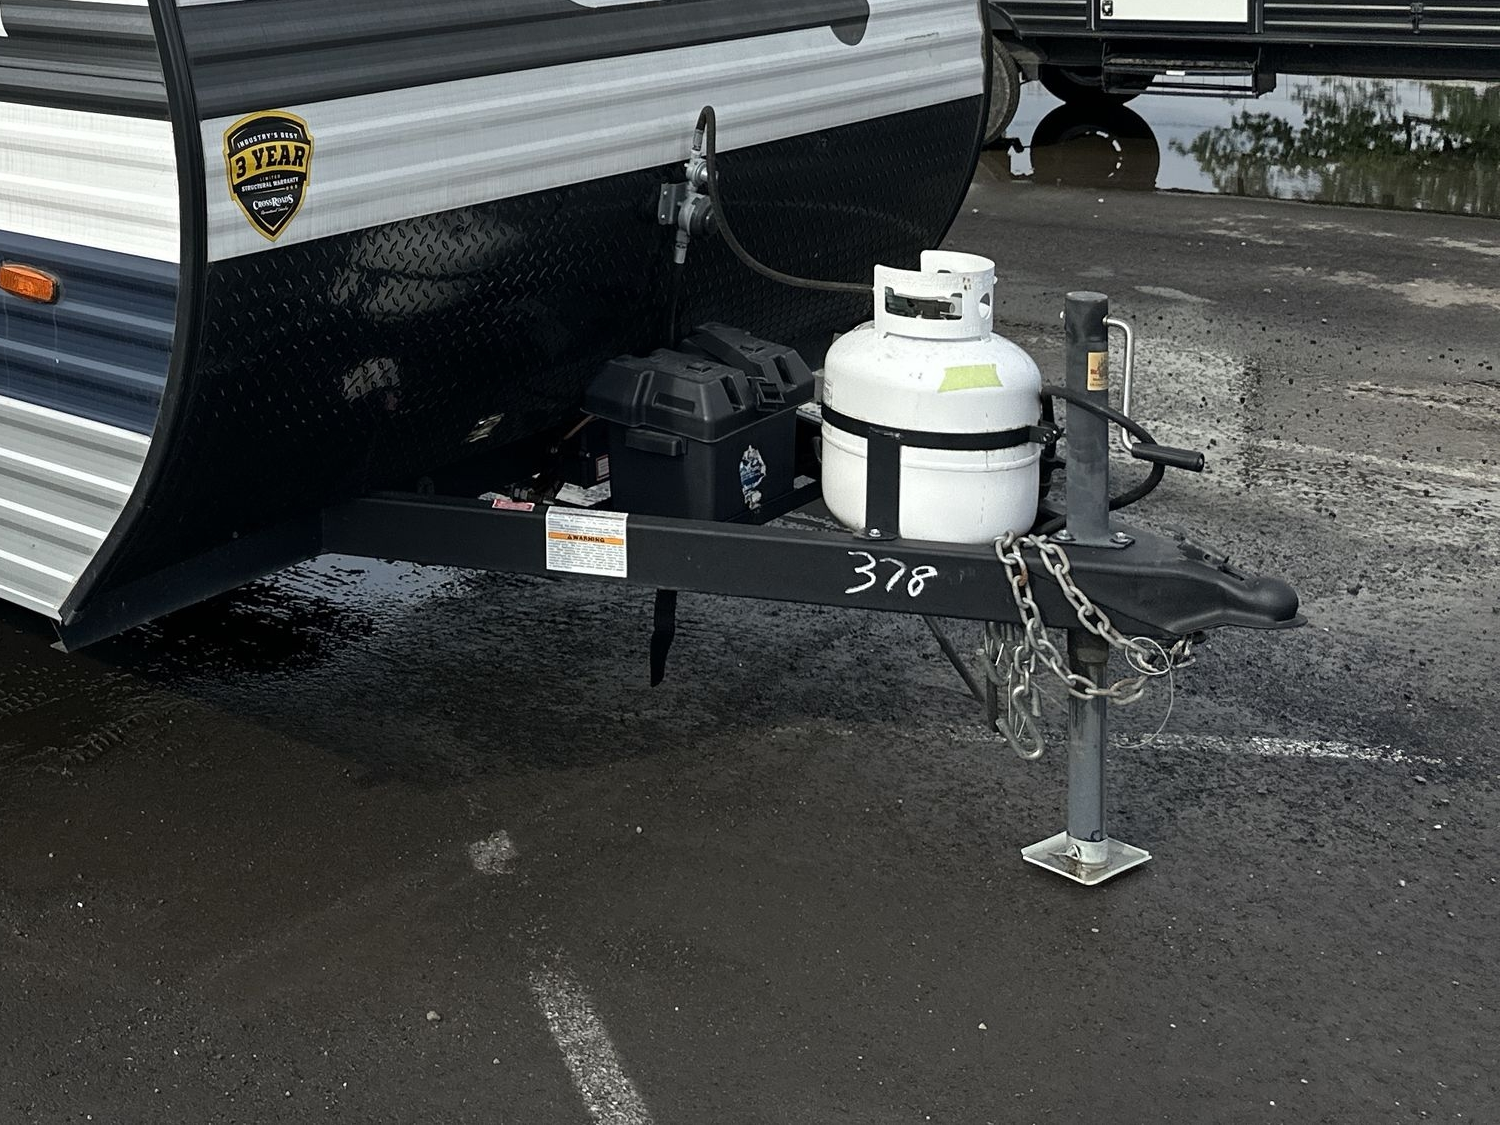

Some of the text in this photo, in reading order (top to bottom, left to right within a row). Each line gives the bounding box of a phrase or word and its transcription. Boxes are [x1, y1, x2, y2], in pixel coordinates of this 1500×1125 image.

[237, 132, 278, 148] INDUSTRY'S
[235, 144, 306, 179] 3 YEAR
[572, 534, 605, 543] WARNING
[845, 551, 938, 597] 378
